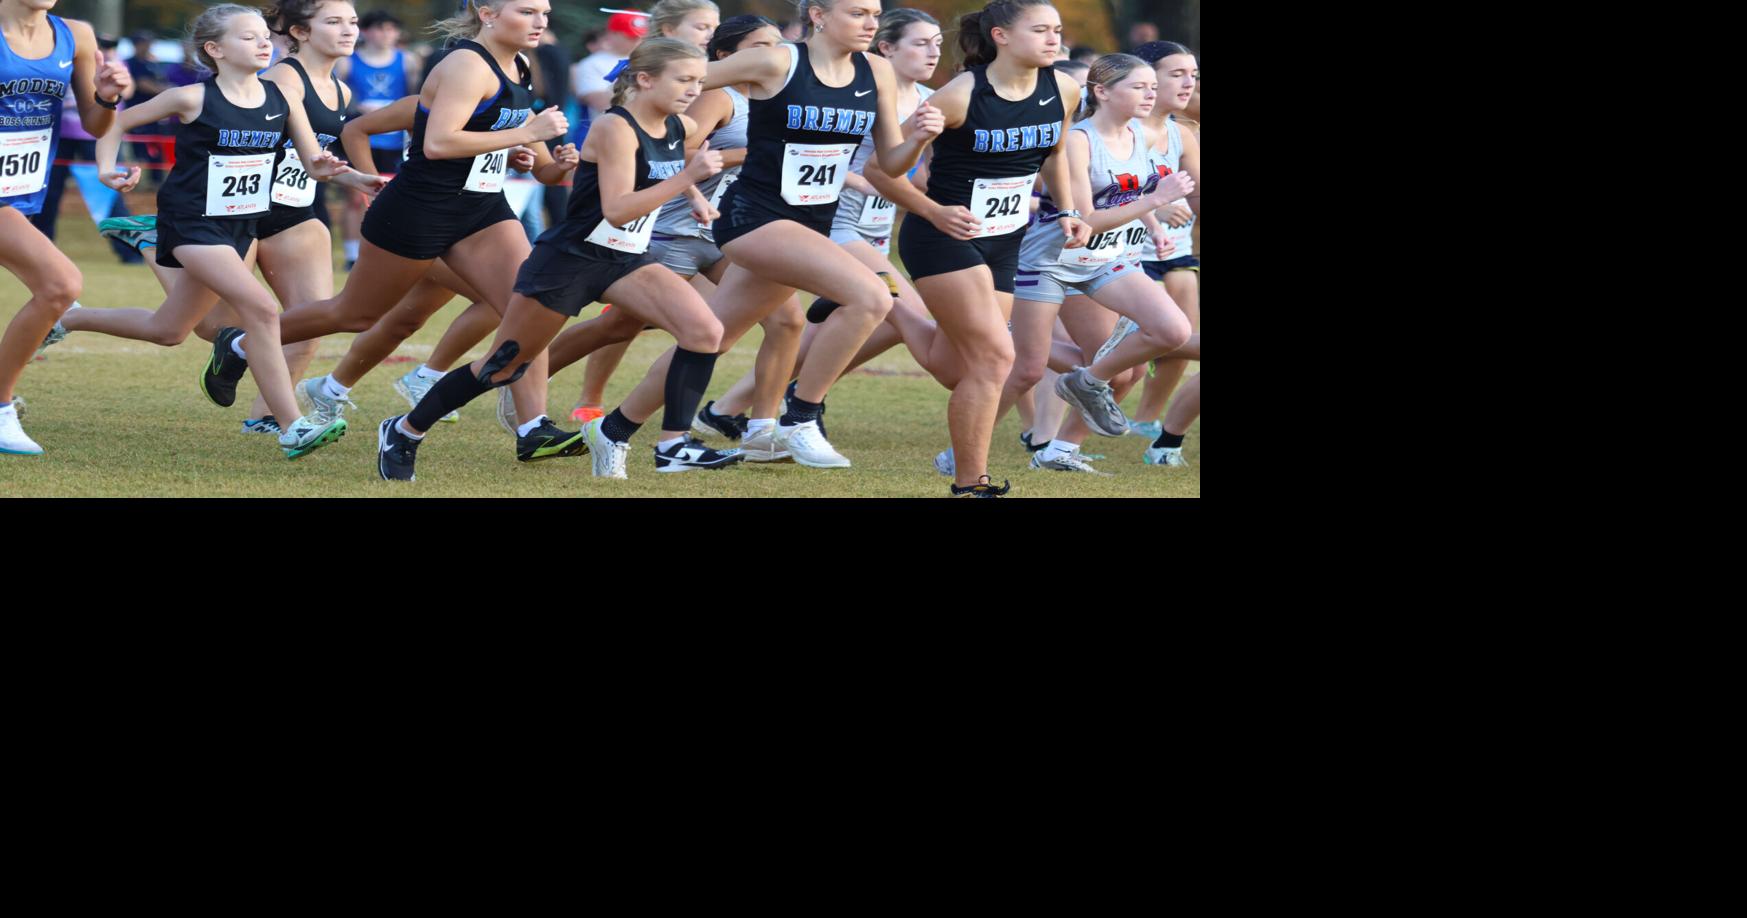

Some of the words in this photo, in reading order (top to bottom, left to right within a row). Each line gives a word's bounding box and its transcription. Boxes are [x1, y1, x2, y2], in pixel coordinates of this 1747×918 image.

[0, 78, 65, 101] MODEL
[0, 151, 41, 177] 1510
[480, 153, 504, 174] 240
[797, 164, 837, 186] 241
[222, 173, 262, 197] 243
[275, 166, 309, 190] 238
[985, 193, 1021, 219] 242
